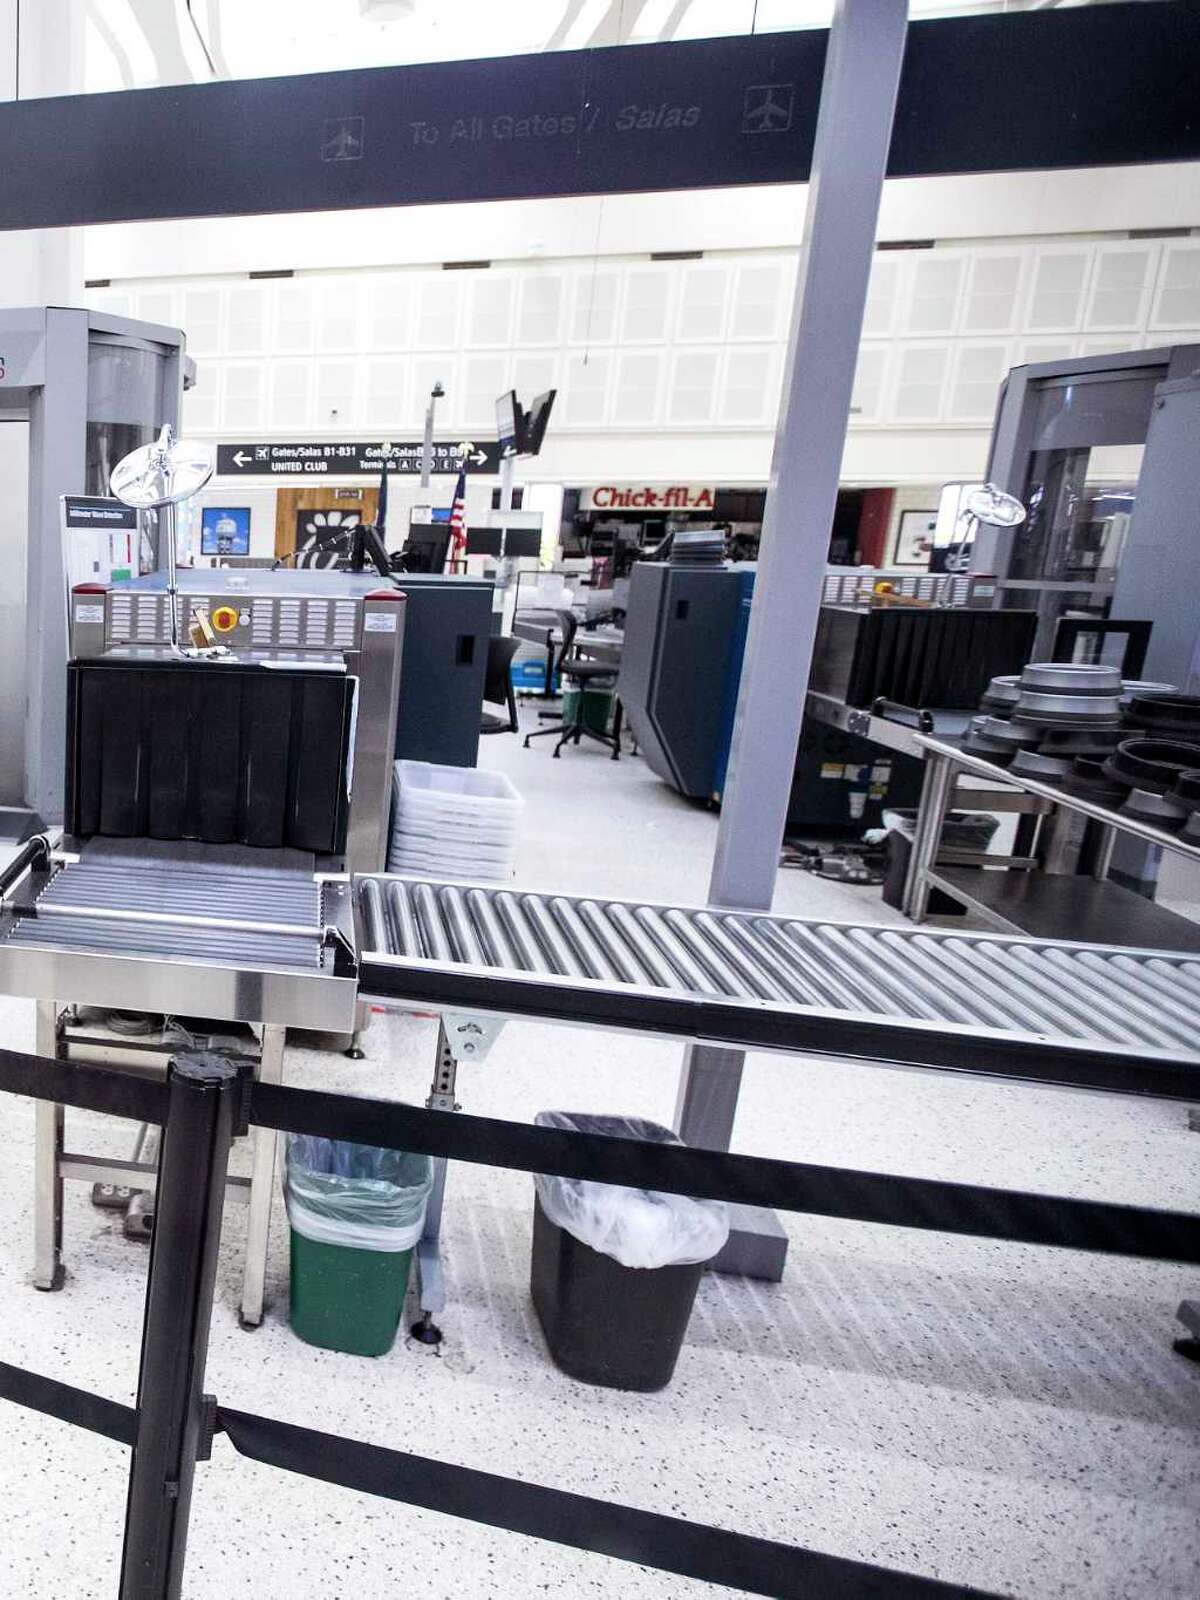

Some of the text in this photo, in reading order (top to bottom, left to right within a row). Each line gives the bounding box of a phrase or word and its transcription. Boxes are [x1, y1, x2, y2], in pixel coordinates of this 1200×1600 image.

[410, 120, 439, 144] To
[450, 116, 484, 142] All
[492, 113, 576, 140] Gates
[615, 103, 701, 131] Salas
[271, 447, 321, 458] Gates/Salas
[271, 462, 328, 472] UNITED CLUB
[592, 486, 714, 508] Chick-fil-A
